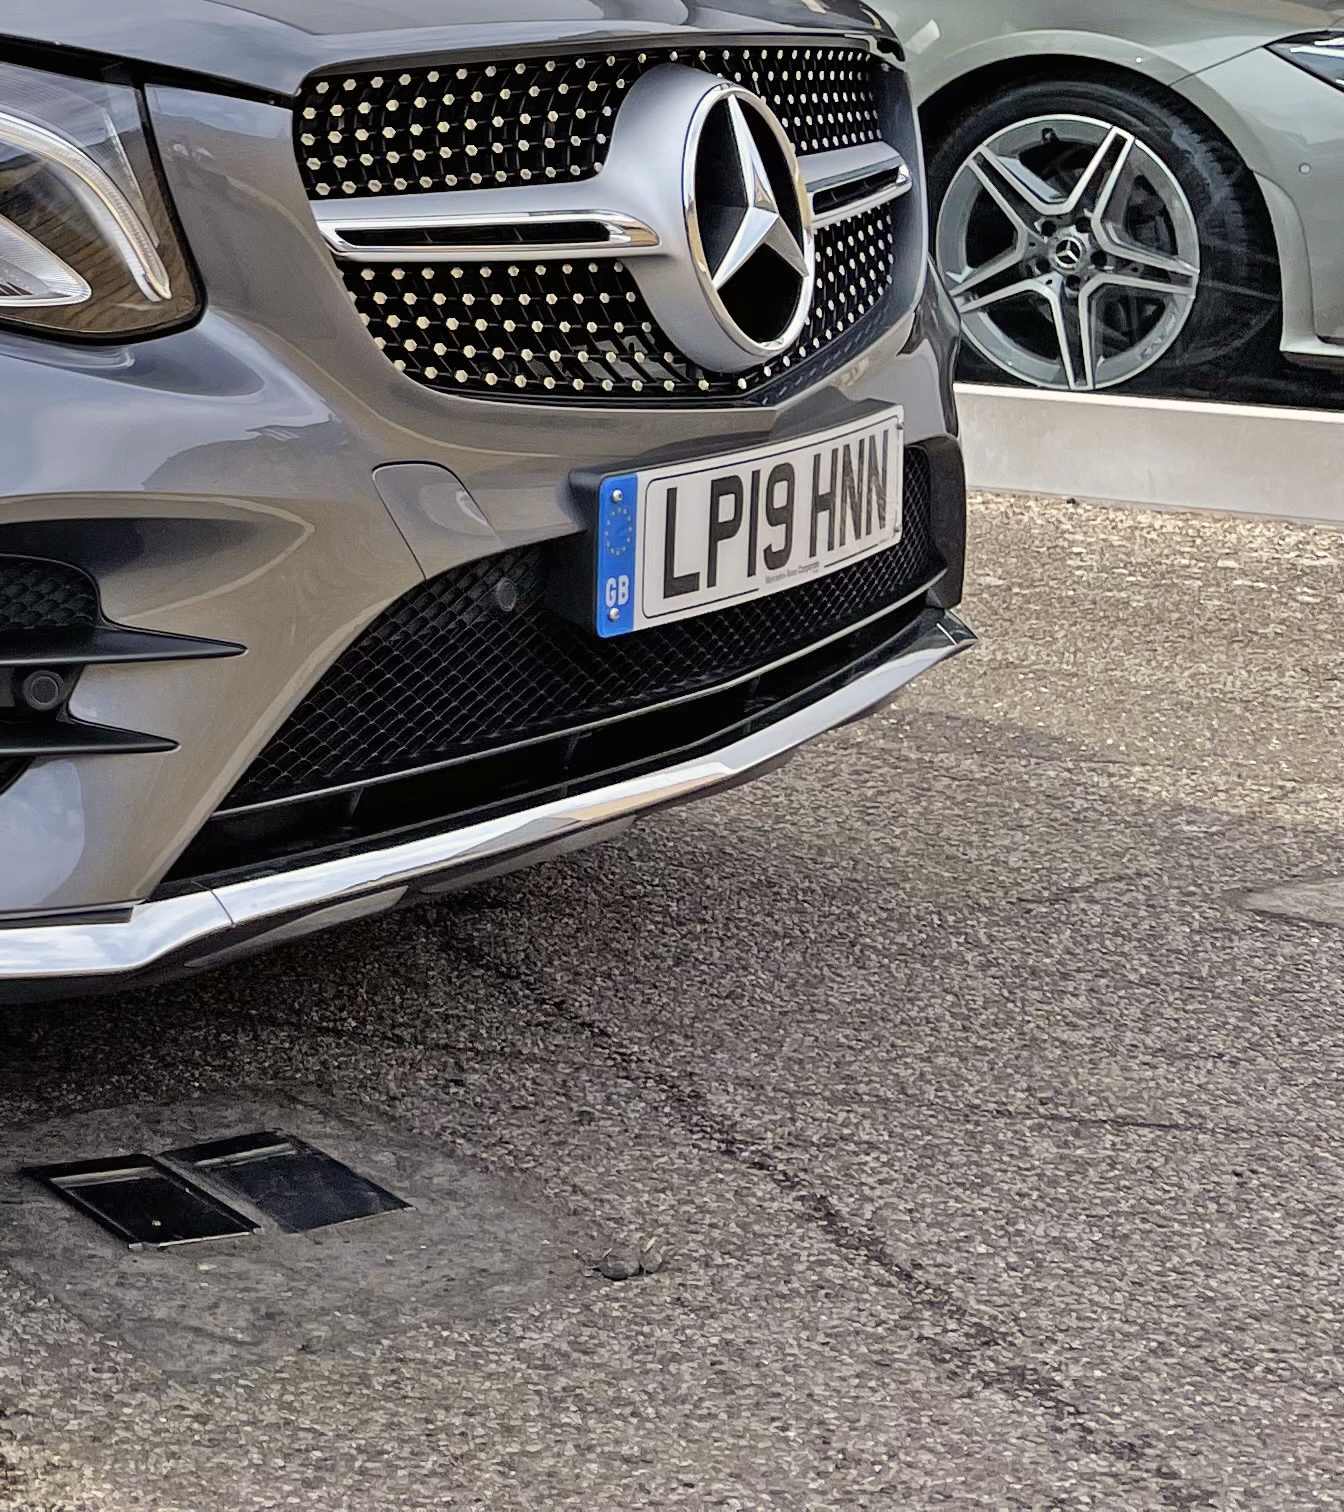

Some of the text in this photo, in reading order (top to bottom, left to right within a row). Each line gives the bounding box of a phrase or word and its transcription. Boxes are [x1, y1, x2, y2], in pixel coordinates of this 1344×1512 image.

[663, 429, 890, 599] LP19 HNN
[605, 574, 630, 608] GB
